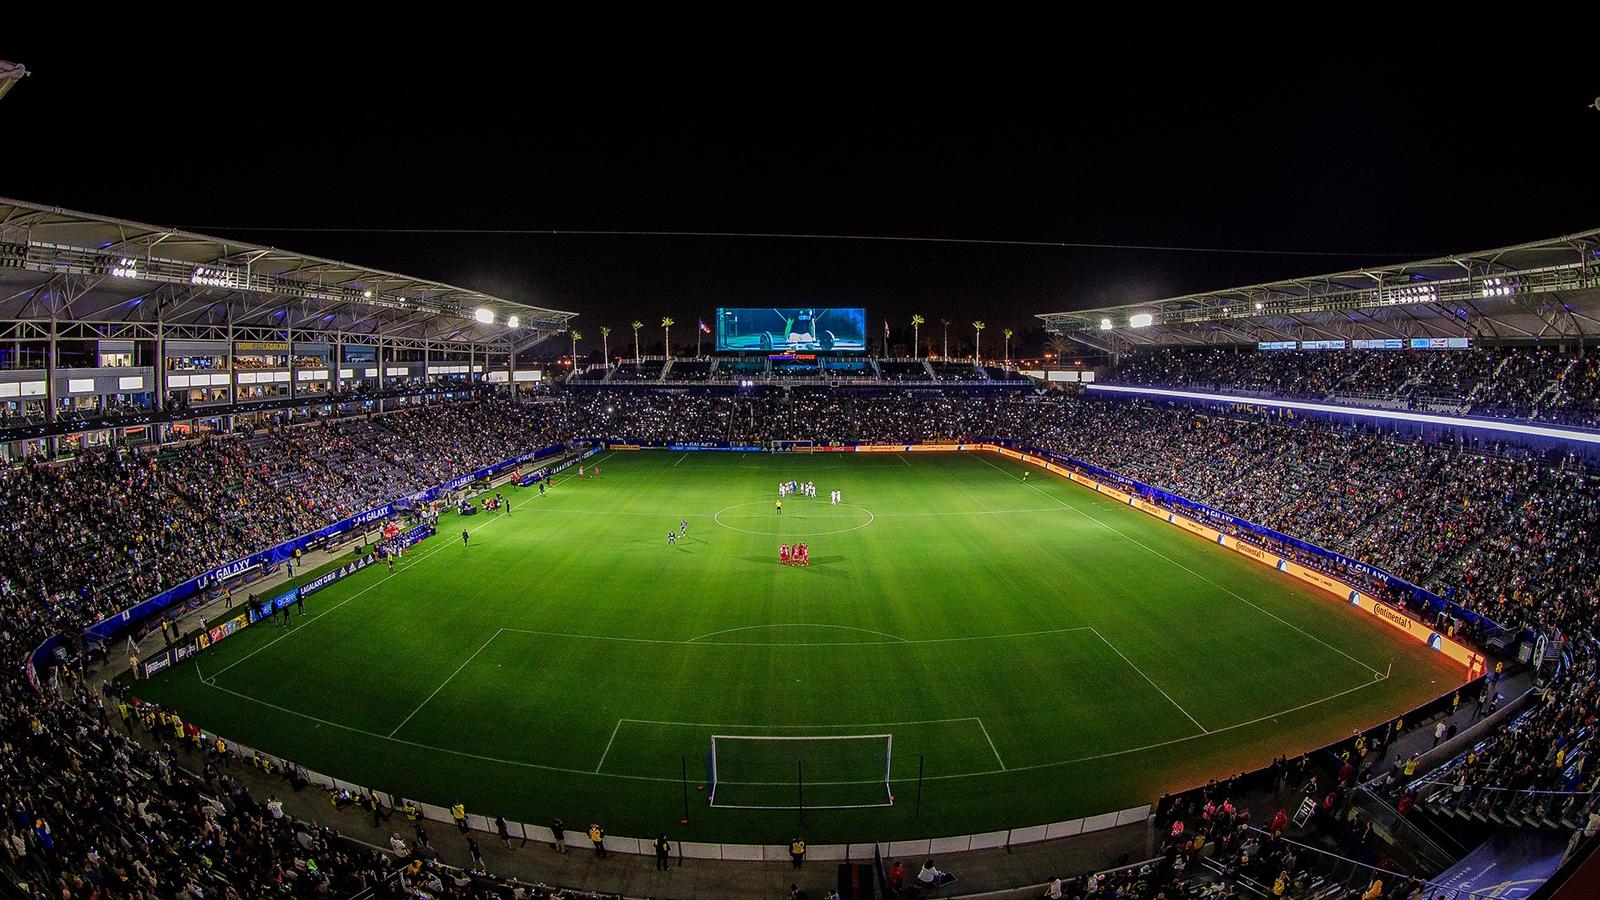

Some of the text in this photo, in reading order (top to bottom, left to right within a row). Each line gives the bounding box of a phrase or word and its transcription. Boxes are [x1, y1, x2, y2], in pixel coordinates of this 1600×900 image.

[366, 505, 389, 521] GALAXY
[197, 558, 250, 590] LA GALAXY
[1373, 603, 1407, 628] Continental
